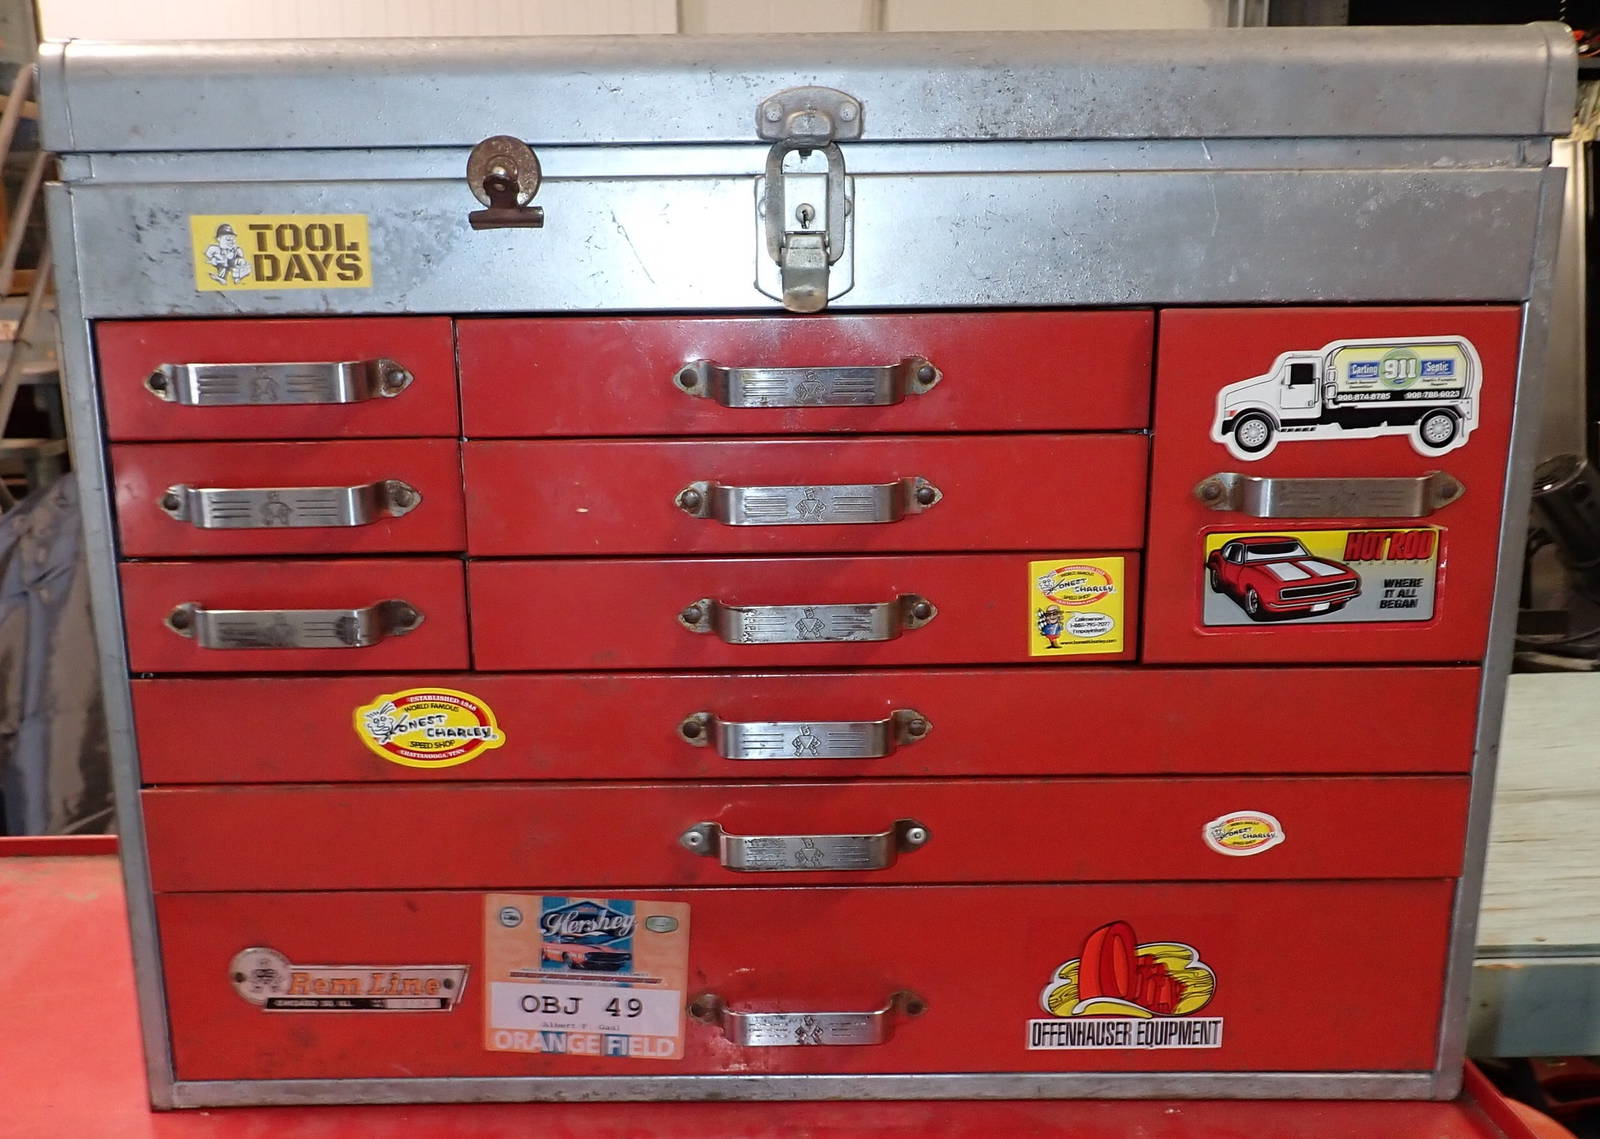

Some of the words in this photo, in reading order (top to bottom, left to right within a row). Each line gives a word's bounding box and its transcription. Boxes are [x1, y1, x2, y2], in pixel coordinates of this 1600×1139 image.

[249, 224, 359, 252] TOOL
[254, 253, 363, 281] DAYS
[1351, 365, 1378, 377] Carting
[1384, 359, 1417, 379] 911
[1425, 362, 1449, 374] Septic
[1343, 531, 1391, 561] HOT
[1387, 531, 1436, 561] ROD
[1383, 578, 1424, 588] WHERE
[1384, 589, 1395, 598] IT
[1397, 588, 1418, 598] ALL
[1379, 599, 1418, 609] BEGAN
[404, 703, 430, 713] WORLD
[430, 702, 460, 712] FAMOUS
[409, 695, 460, 705] ESTABLISHED
[409, 740, 433, 749] SPEED
[434, 739, 456, 748] SHOP
[426, 727, 492, 739] CHARLEY
[543, 909, 635, 936] Hershey
[287, 972, 364, 996] Rem
[367, 972, 442, 996] Line
[521, 994, 583, 1015] OBJ
[605, 997, 643, 1018] 49
[495, 1030, 600, 1054] ORANGE
[607, 1034, 675, 1058] FIELD
[1032, 1020, 1133, 1047] OFFENHAUSER
[1136, 1020, 1221, 1047] EQUIPMENT
